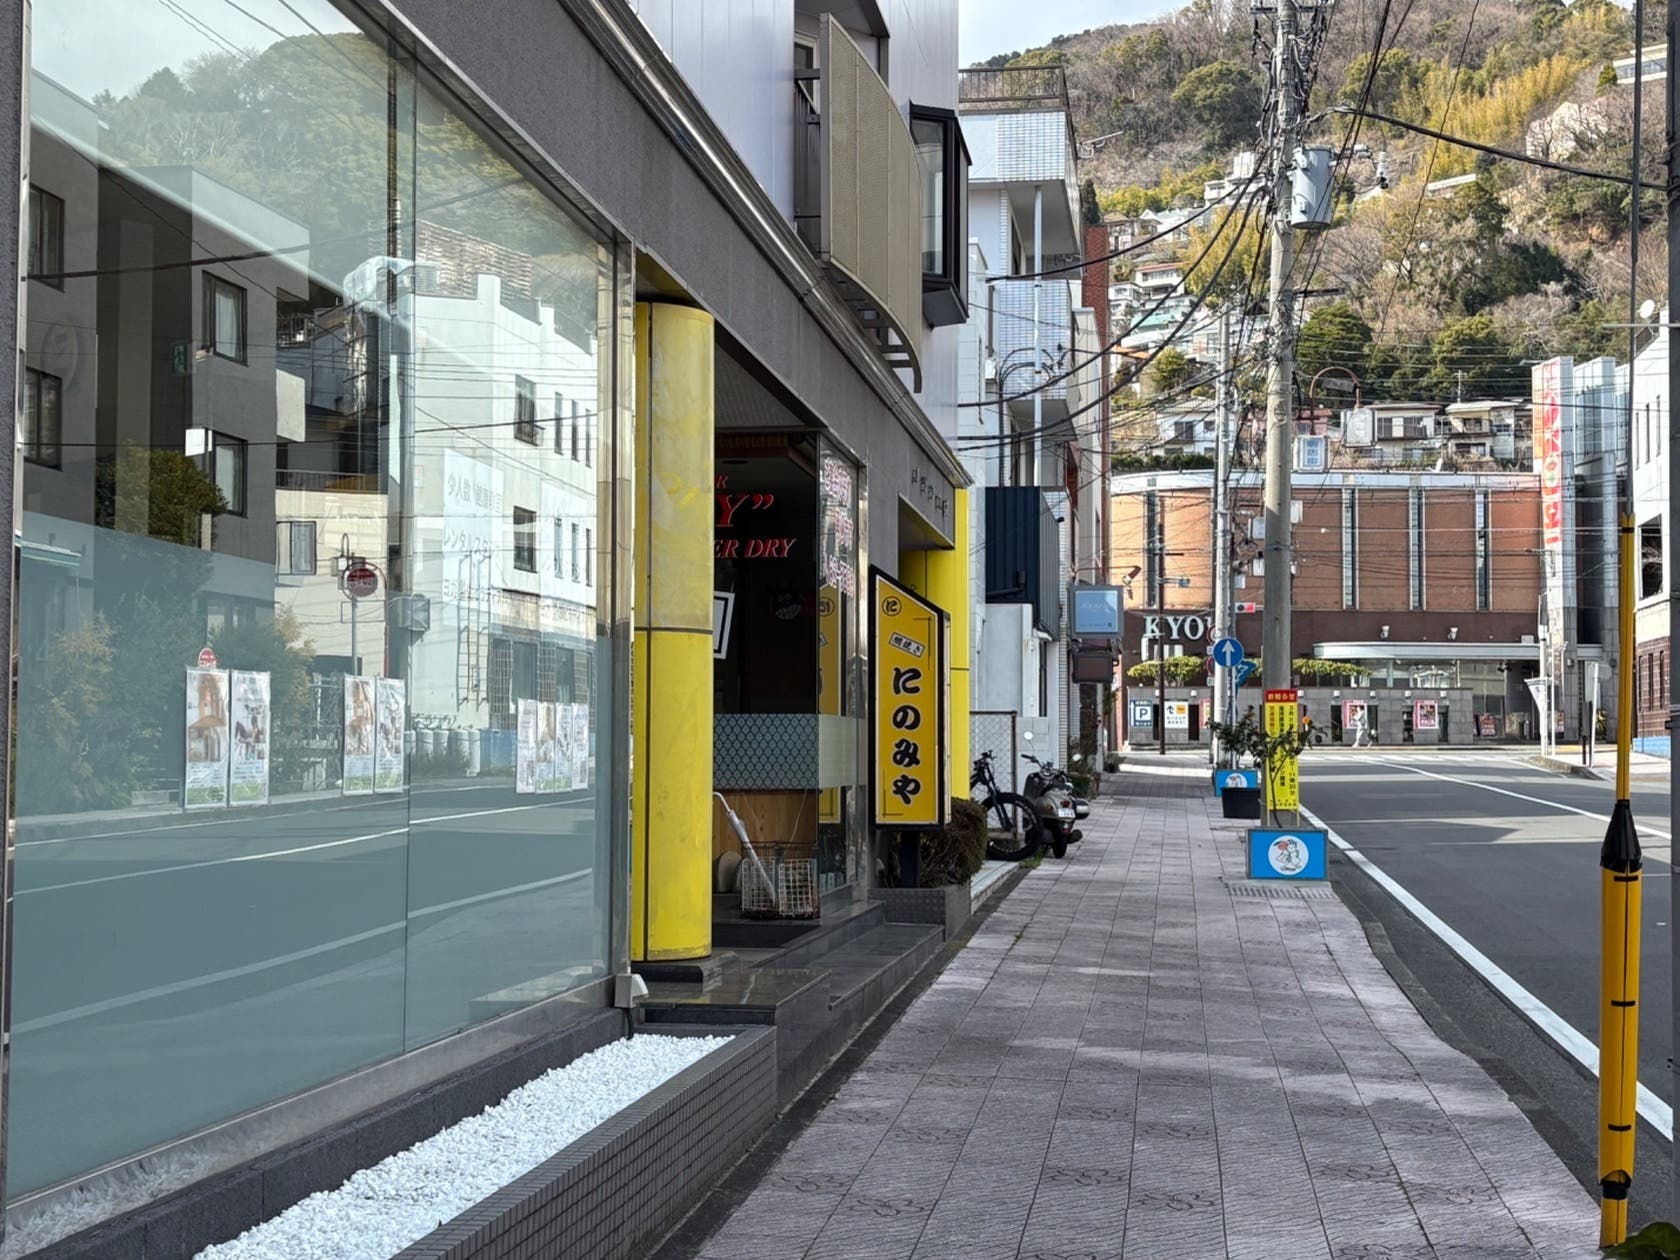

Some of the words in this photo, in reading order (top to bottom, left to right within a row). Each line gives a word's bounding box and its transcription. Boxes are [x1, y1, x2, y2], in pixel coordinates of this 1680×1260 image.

[744, 537, 797, 558] DRY
[1143, 615, 1212, 640] KYO
[1139, 708, 1149, 719] P
[891, 666, 922, 805] にのみや
